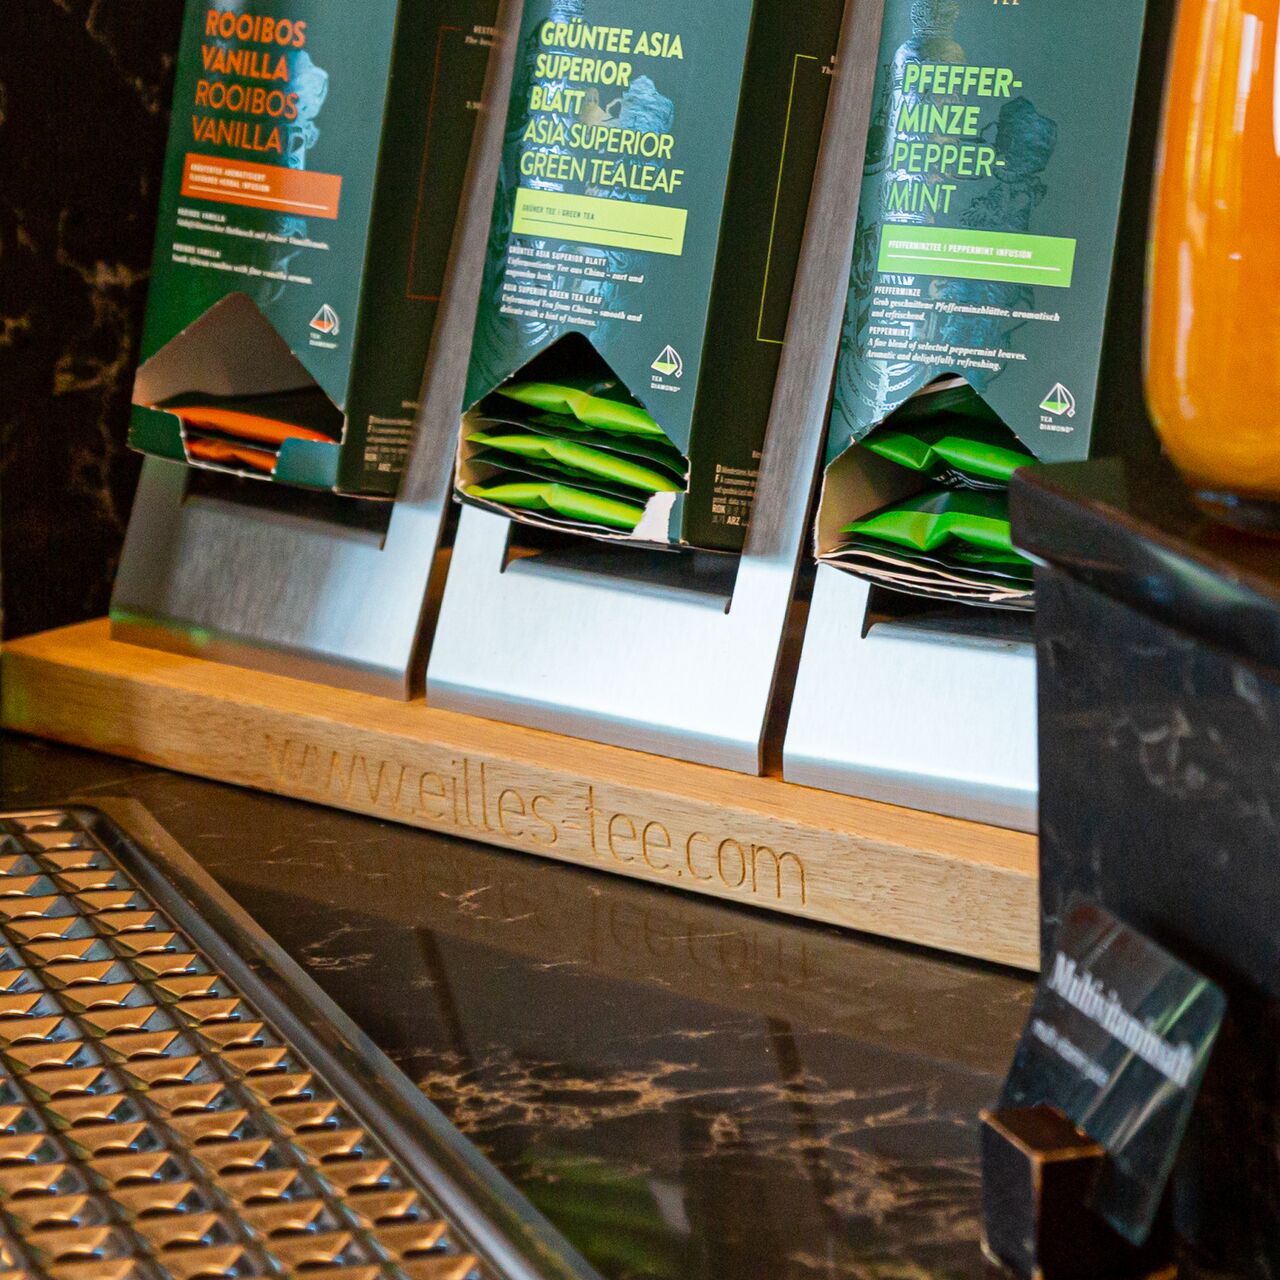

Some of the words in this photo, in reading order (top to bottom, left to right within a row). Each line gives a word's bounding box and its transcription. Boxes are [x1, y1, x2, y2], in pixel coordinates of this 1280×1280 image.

[205, 9, 307, 48] ROOIBOS
[541, 17, 633, 54] GRÜNTEE
[634, 31, 684, 60] ASIA
[200, 44, 289, 82] VANILLA
[535, 53, 632, 87] SUPERIOR
[903, 64, 1023, 98] PFEFFER-
[194, 80, 300, 120] ROOIBOS
[530, 86, 586, 115] BLATT
[191, 114, 283, 154] VANILLA
[897, 104, 980, 136] MINZE
[523, 119, 566, 147] ASIA
[569, 122, 674, 159] SUPERIOR
[520, 151, 586, 183] GREEN
[591, 158, 628, 186] TEA
[629, 164, 684, 194] LEAF
[892, 142, 1006, 177] PEPPER-
[887, 182, 957, 214] MINT
[562, 209, 581, 218] GREEN
[584, 212, 595, 220] TEA
[536, 249, 550, 258] ASIA
[552, 251, 584, 264] SUPERIOR
[585, 256, 607, 266] BLATT
[948, 243, 994, 256] PEPPERMINT
[996, 248, 1033, 259] INFUSION
[584, 268, 606, 278] China
[503, 283, 517, 292] ASIA
[518, 284, 547, 297] SUPERIOR
[549, 289, 569, 300] GREEN
[571, 292, 584, 302] TEA
[586, 295, 602, 305] LEAF
[874, 286, 921, 297] PFEFFERMINZE
[873, 297, 890, 307] Grob
[1011, 310, 1060, 322] aromatisch
[869, 326, 910, 336] PEPPERMINT
[909, 340, 918, 351] of
[918, 342, 949, 353] selected
[948, 345, 997, 359] peppermint
[997, 349, 1028, 361] leaves.
[956, 357, 1002, 372] refreshing.
[652, 375, 663, 383] TEA
[263, 732, 807, 905] www.eilles-tee.com
